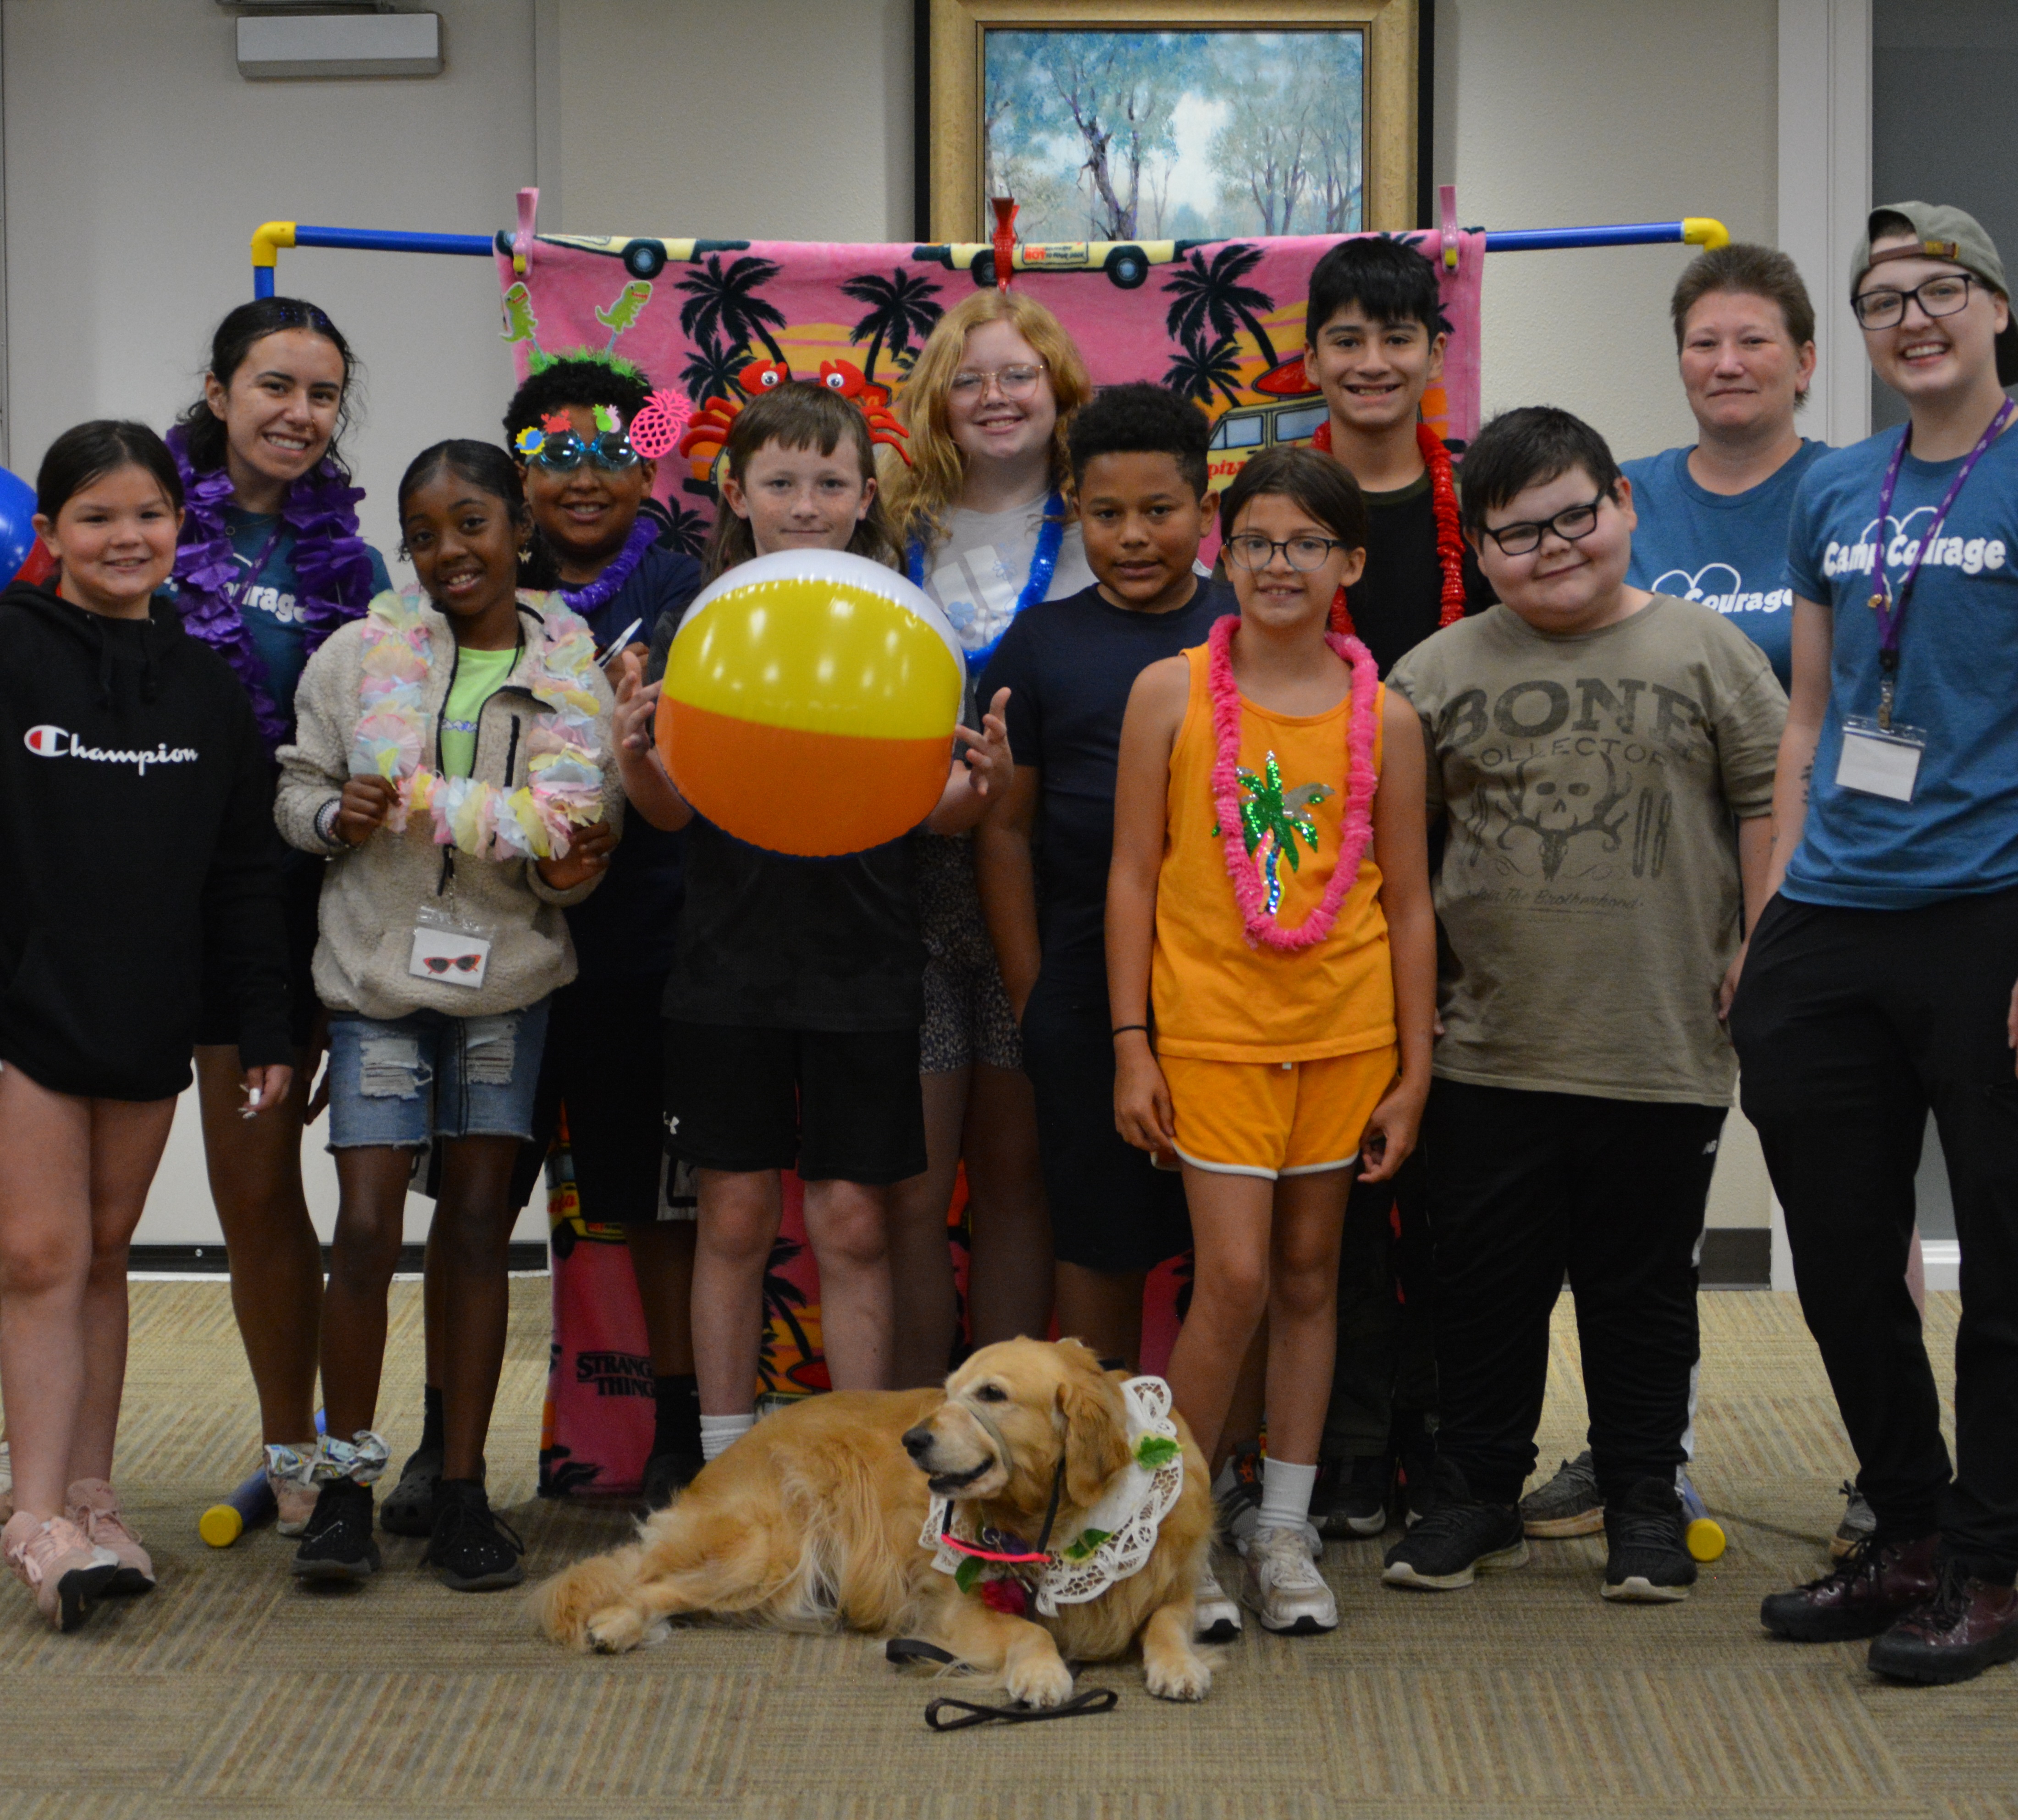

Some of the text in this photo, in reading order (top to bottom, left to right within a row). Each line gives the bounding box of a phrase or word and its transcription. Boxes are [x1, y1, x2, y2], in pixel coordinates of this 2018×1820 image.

[1208, 459, 1246, 480] piz
[24, 725, 199, 776] Champion
[576, 1352, 654, 1379] STRANG
